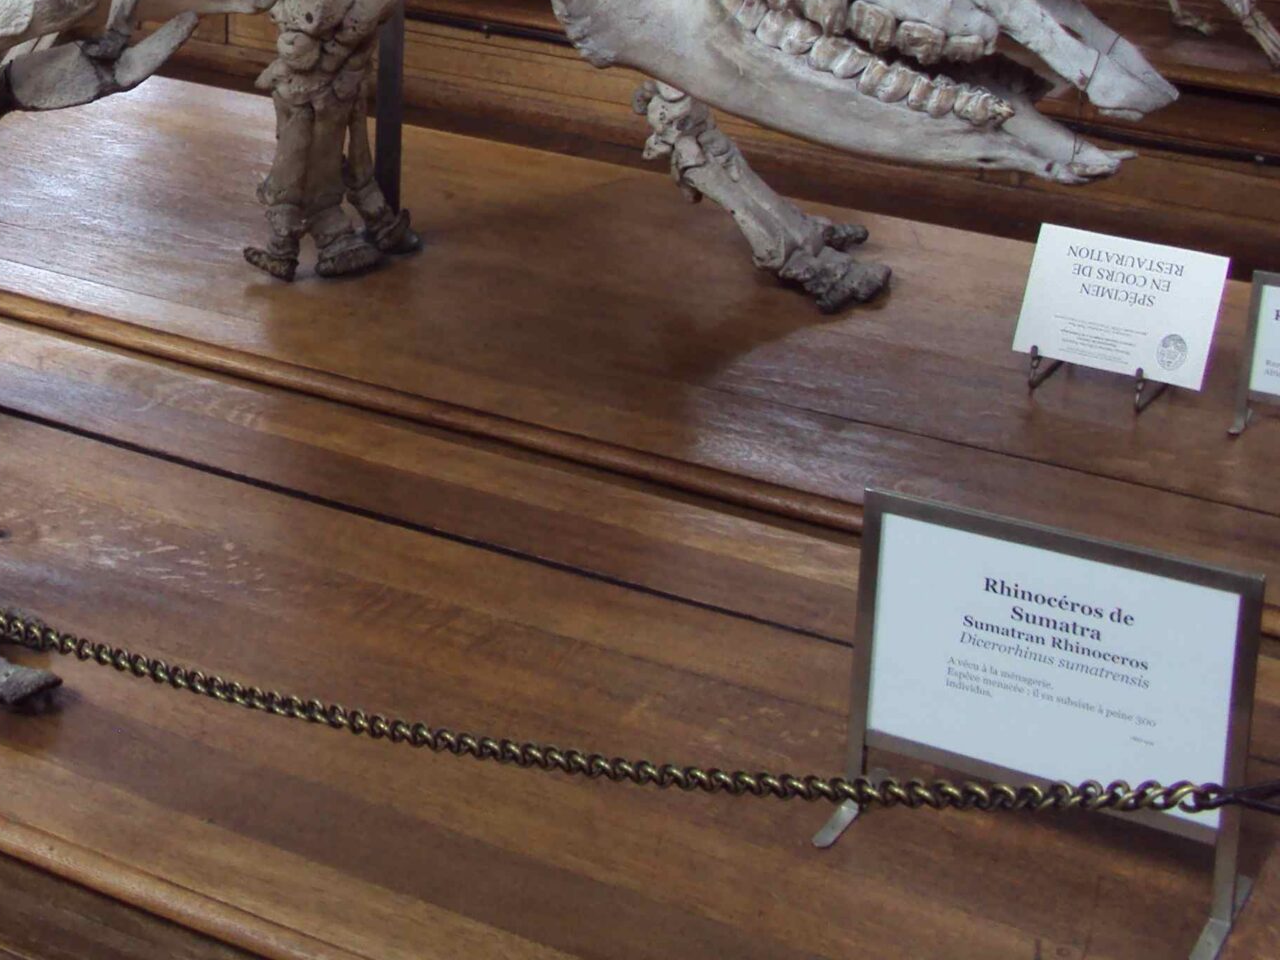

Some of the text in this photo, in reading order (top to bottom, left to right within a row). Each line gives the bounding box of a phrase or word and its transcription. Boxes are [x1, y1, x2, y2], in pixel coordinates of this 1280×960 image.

[1067, 245, 1185, 277] RESTAURATION
[1072, 264, 1171, 292] EN COURS DE
[1080, 283, 1156, 307] SPÉCIMEN
[984, 577, 1135, 626] Rhinocéros de
[1010, 605, 1102, 641] Sumatra
[960, 631, 1150, 690] Dicerorhinus sumatrensis
[963, 614, 1149, 671] Sumatran Rhinoceros
